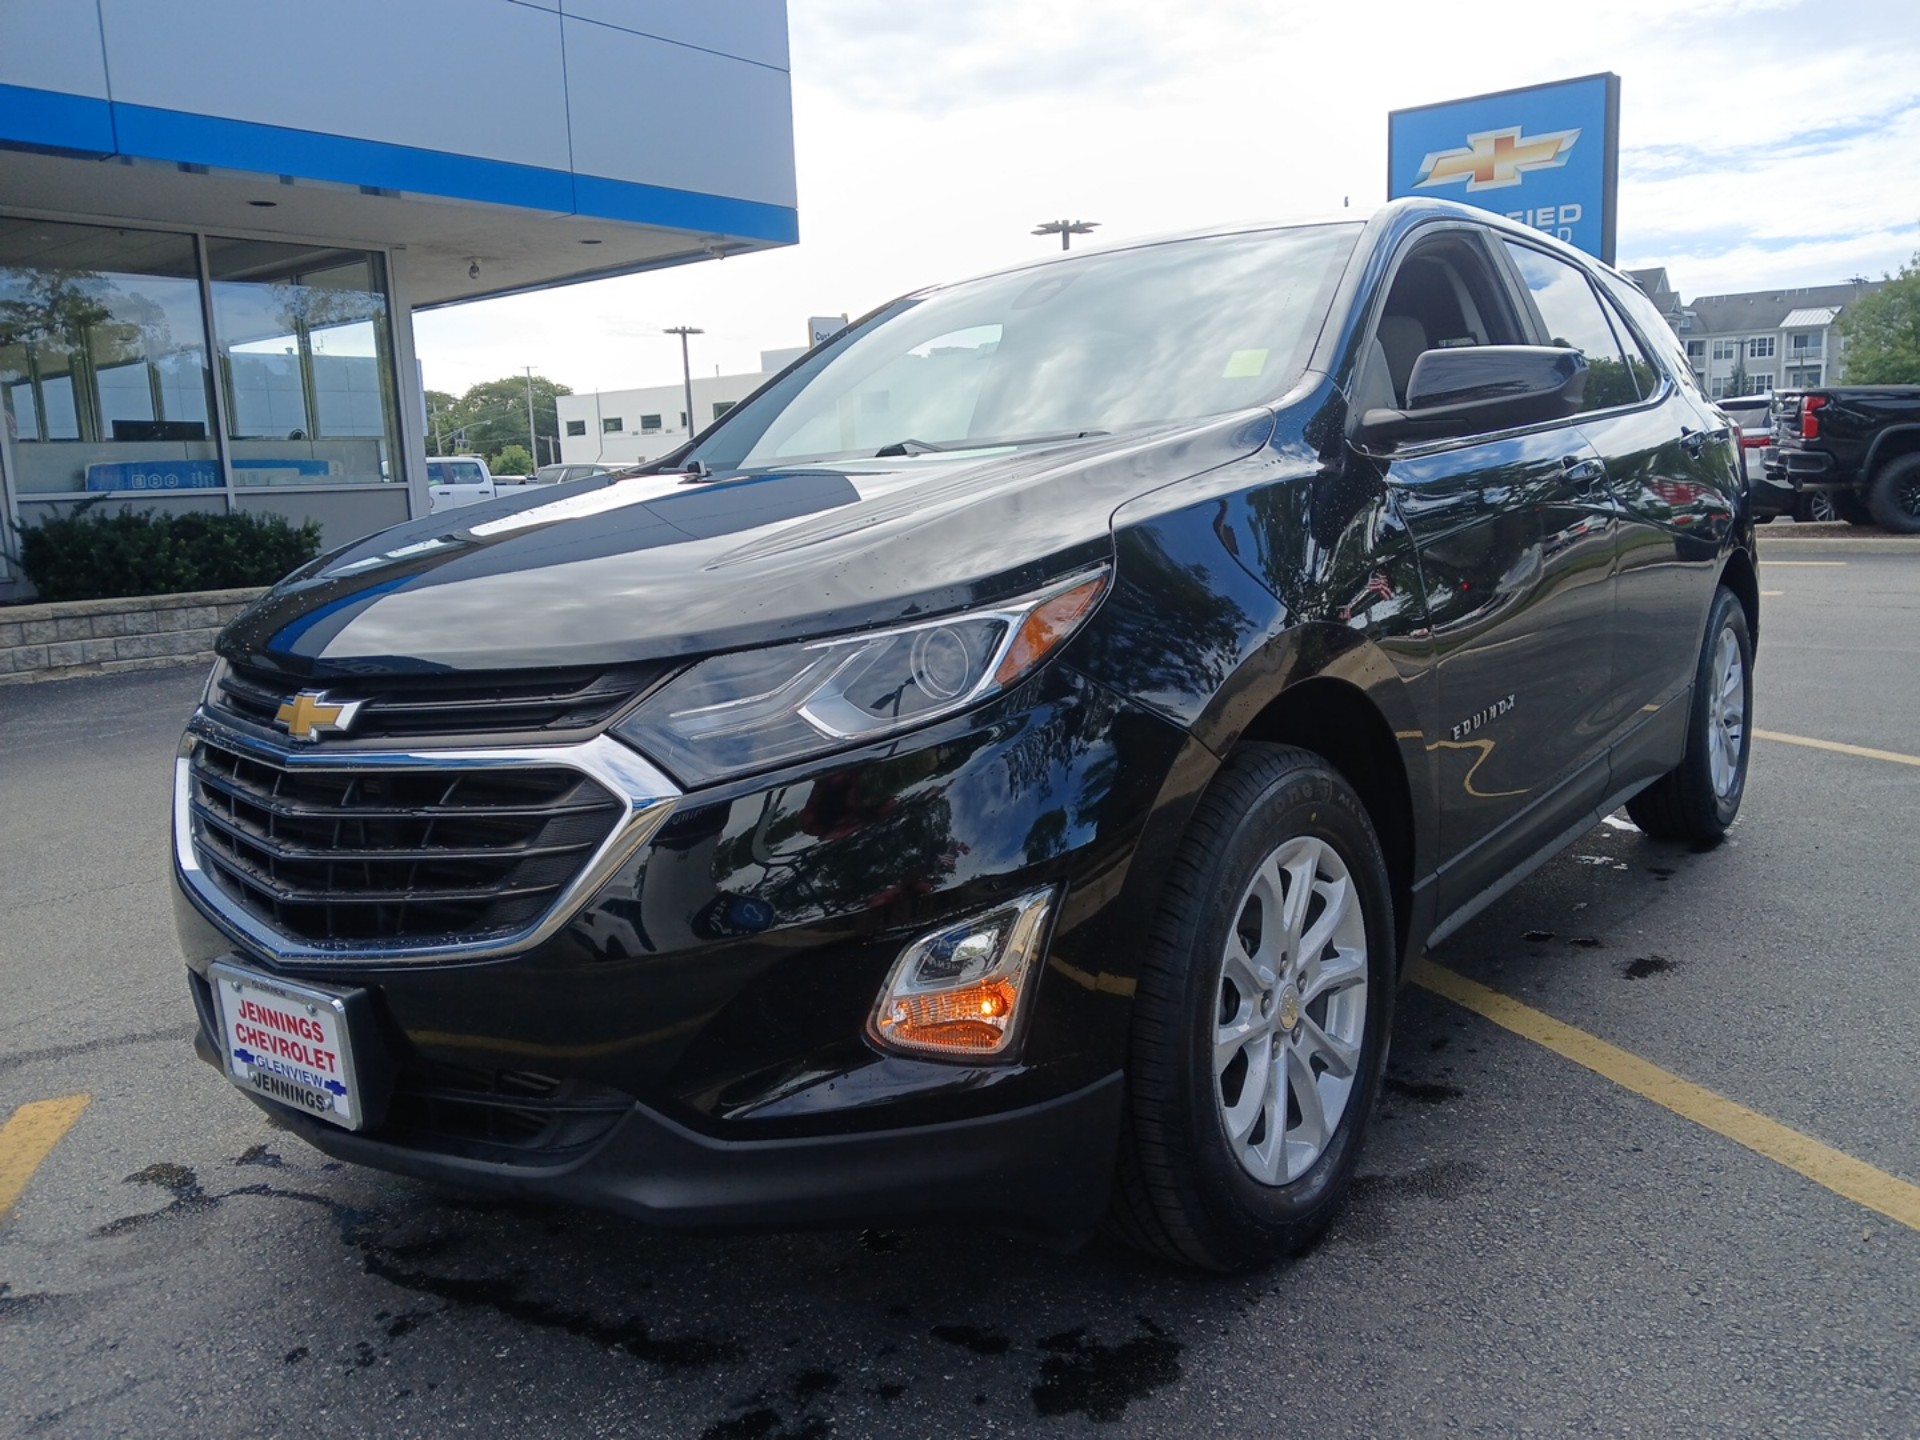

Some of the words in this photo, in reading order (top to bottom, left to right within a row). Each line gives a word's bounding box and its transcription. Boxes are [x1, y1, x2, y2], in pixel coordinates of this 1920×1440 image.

[1452, 694, 1515, 740] EQUINOX
[238, 999, 324, 1044] JENNINGS
[235, 1023, 336, 1074] CHEVROLET
[255, 1054, 323, 1089] GLENVIEW
[255, 1072, 325, 1113] JENNINGS
